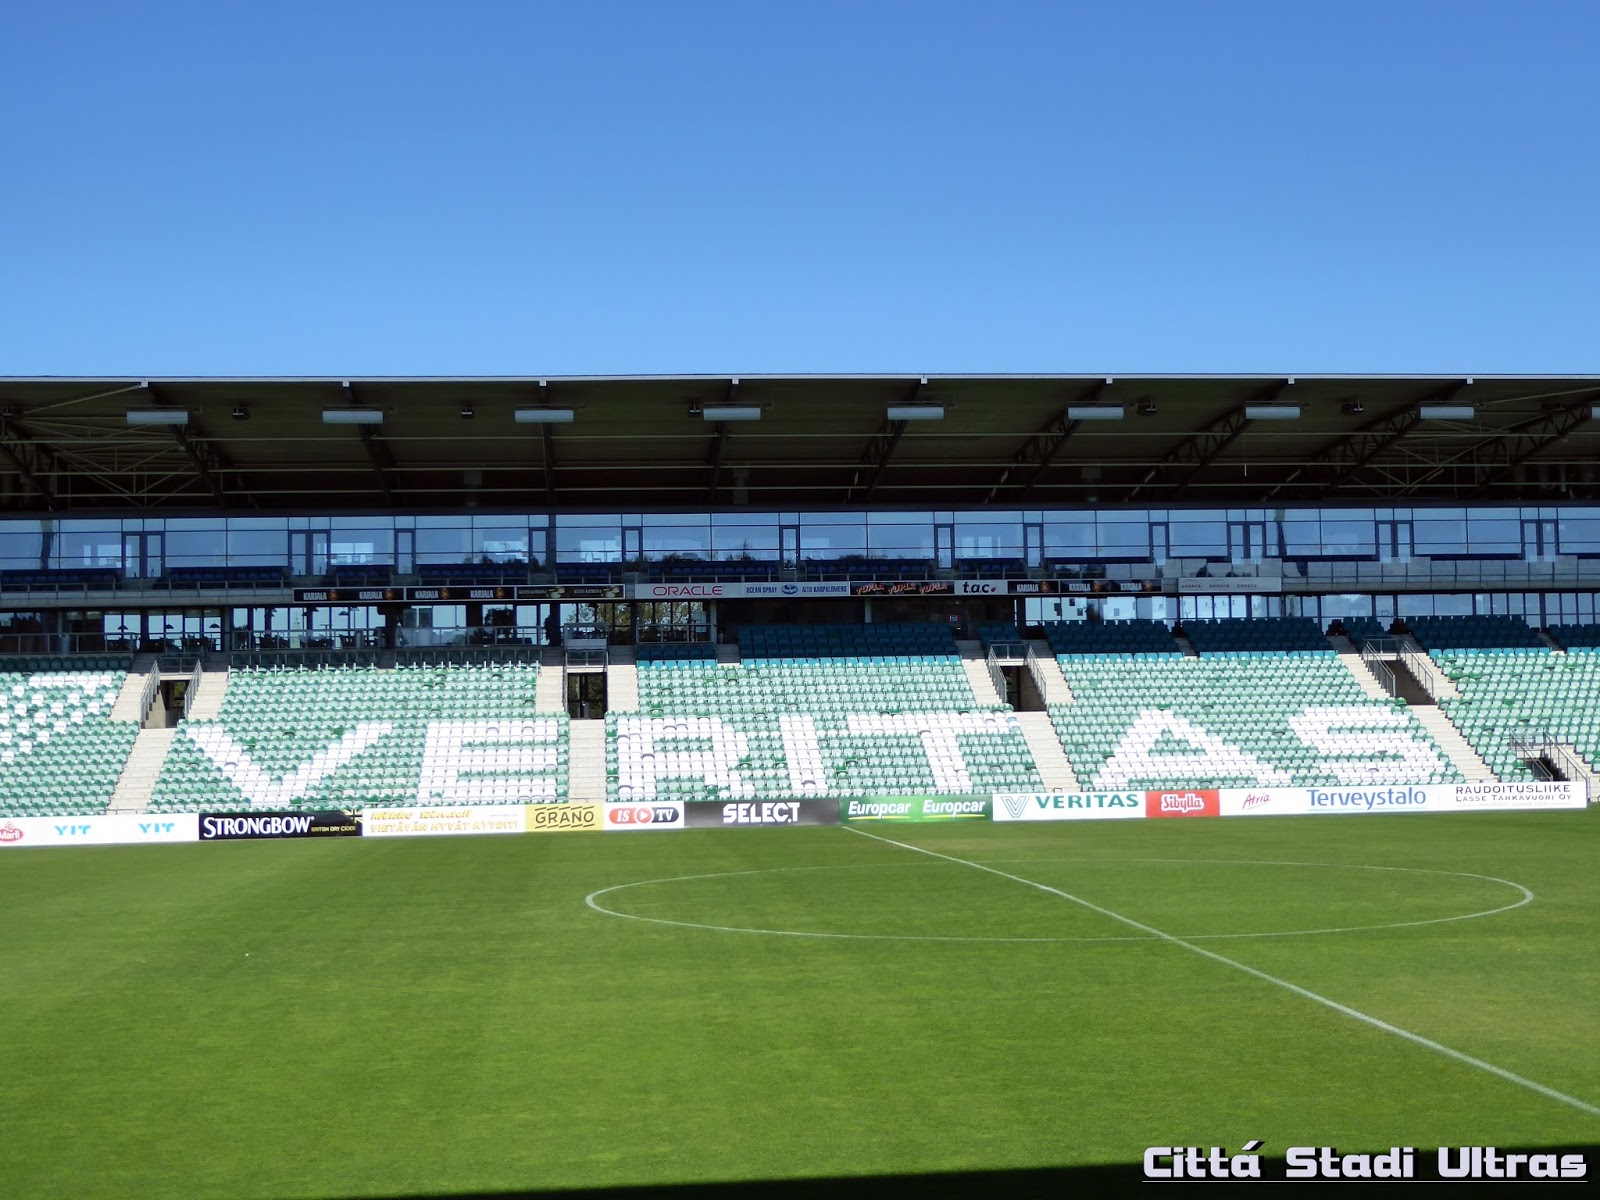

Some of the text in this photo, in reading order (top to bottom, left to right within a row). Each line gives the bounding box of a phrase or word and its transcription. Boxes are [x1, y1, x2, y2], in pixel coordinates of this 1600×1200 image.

[653, 585, 723, 596] ORACLE
[746, 586, 777, 594] OCEAN SPRAY
[1455, 784, 1571, 794] RAUDOITUSLIIKE
[1035, 794, 1139, 809] VERITAS
[1163, 795, 1202, 812] Sibylla
[1242, 793, 1270, 809] Atria
[1306, 787, 1426, 810] Terveystalo
[616, 809, 674, 823] IS TV
[723, 802, 800, 824] SELECT
[848, 801, 911, 819] Europcar
[923, 800, 985, 817] Europcar
[535, 810, 595, 824] GRANO
[54, 825, 91, 836] YIT
[138, 823, 175, 833] YIT
[203, 816, 310, 838] STRONGBOW
